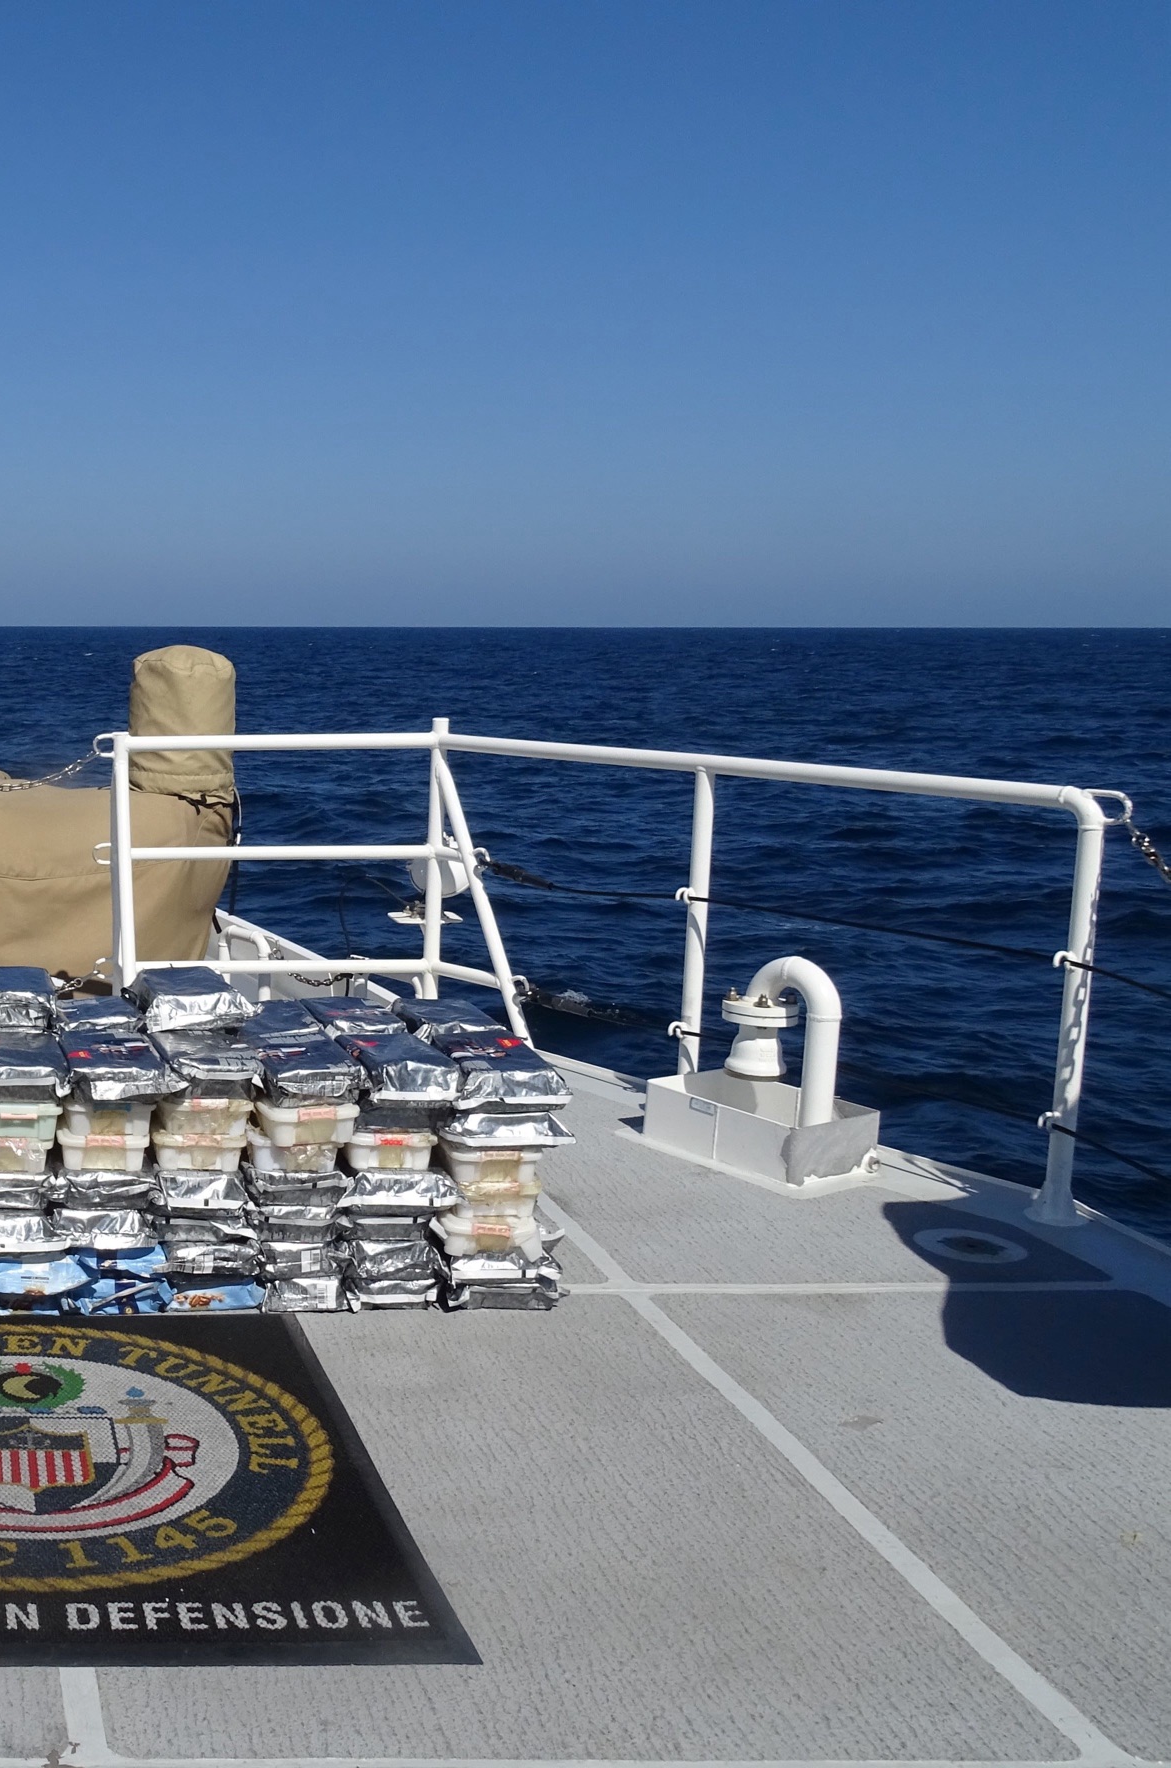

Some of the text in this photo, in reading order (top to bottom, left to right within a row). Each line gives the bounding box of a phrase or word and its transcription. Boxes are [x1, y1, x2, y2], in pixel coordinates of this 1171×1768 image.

[118, 1346, 300, 1474] TUNNELL
[58, 1509, 238, 1568] 1145
[66, 1600, 430, 1630] DEFENSIONE
